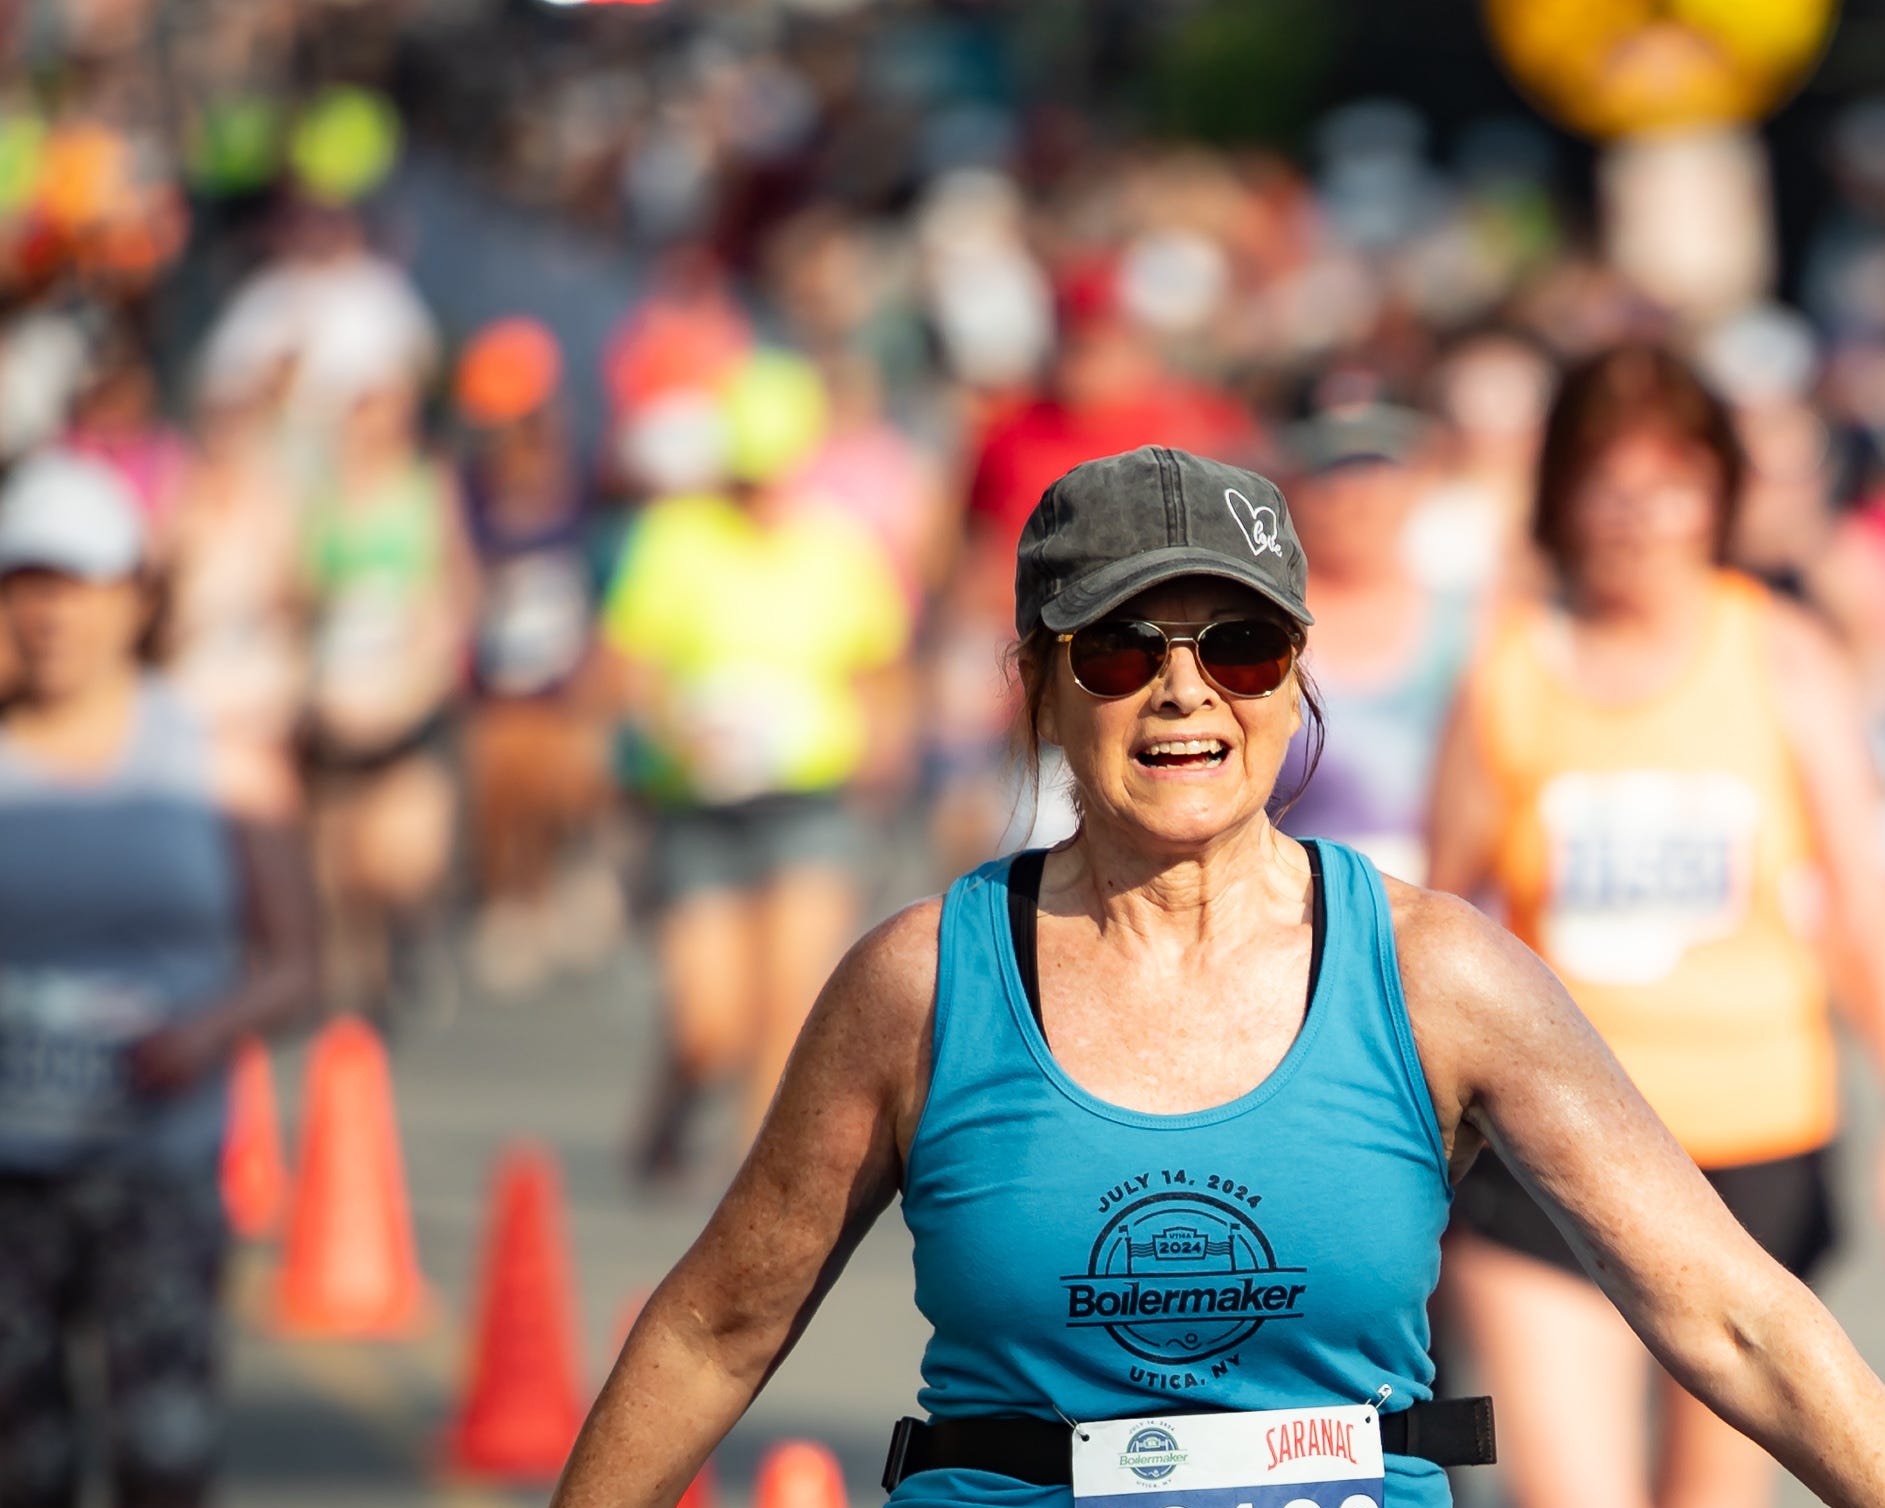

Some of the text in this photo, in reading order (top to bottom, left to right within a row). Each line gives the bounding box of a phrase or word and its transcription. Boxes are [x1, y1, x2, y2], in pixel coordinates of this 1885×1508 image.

[1098, 1170, 1262, 1213] JULY 14, 2024
[1159, 1241, 1201, 1254] 2024
[1060, 1278, 1306, 1318] Boilermaker
[1129, 1353, 1241, 1389] UTICA, NY
[1120, 1453, 1188, 1466] Boilermaker
[1265, 1418, 1357, 1471] SARANAC
